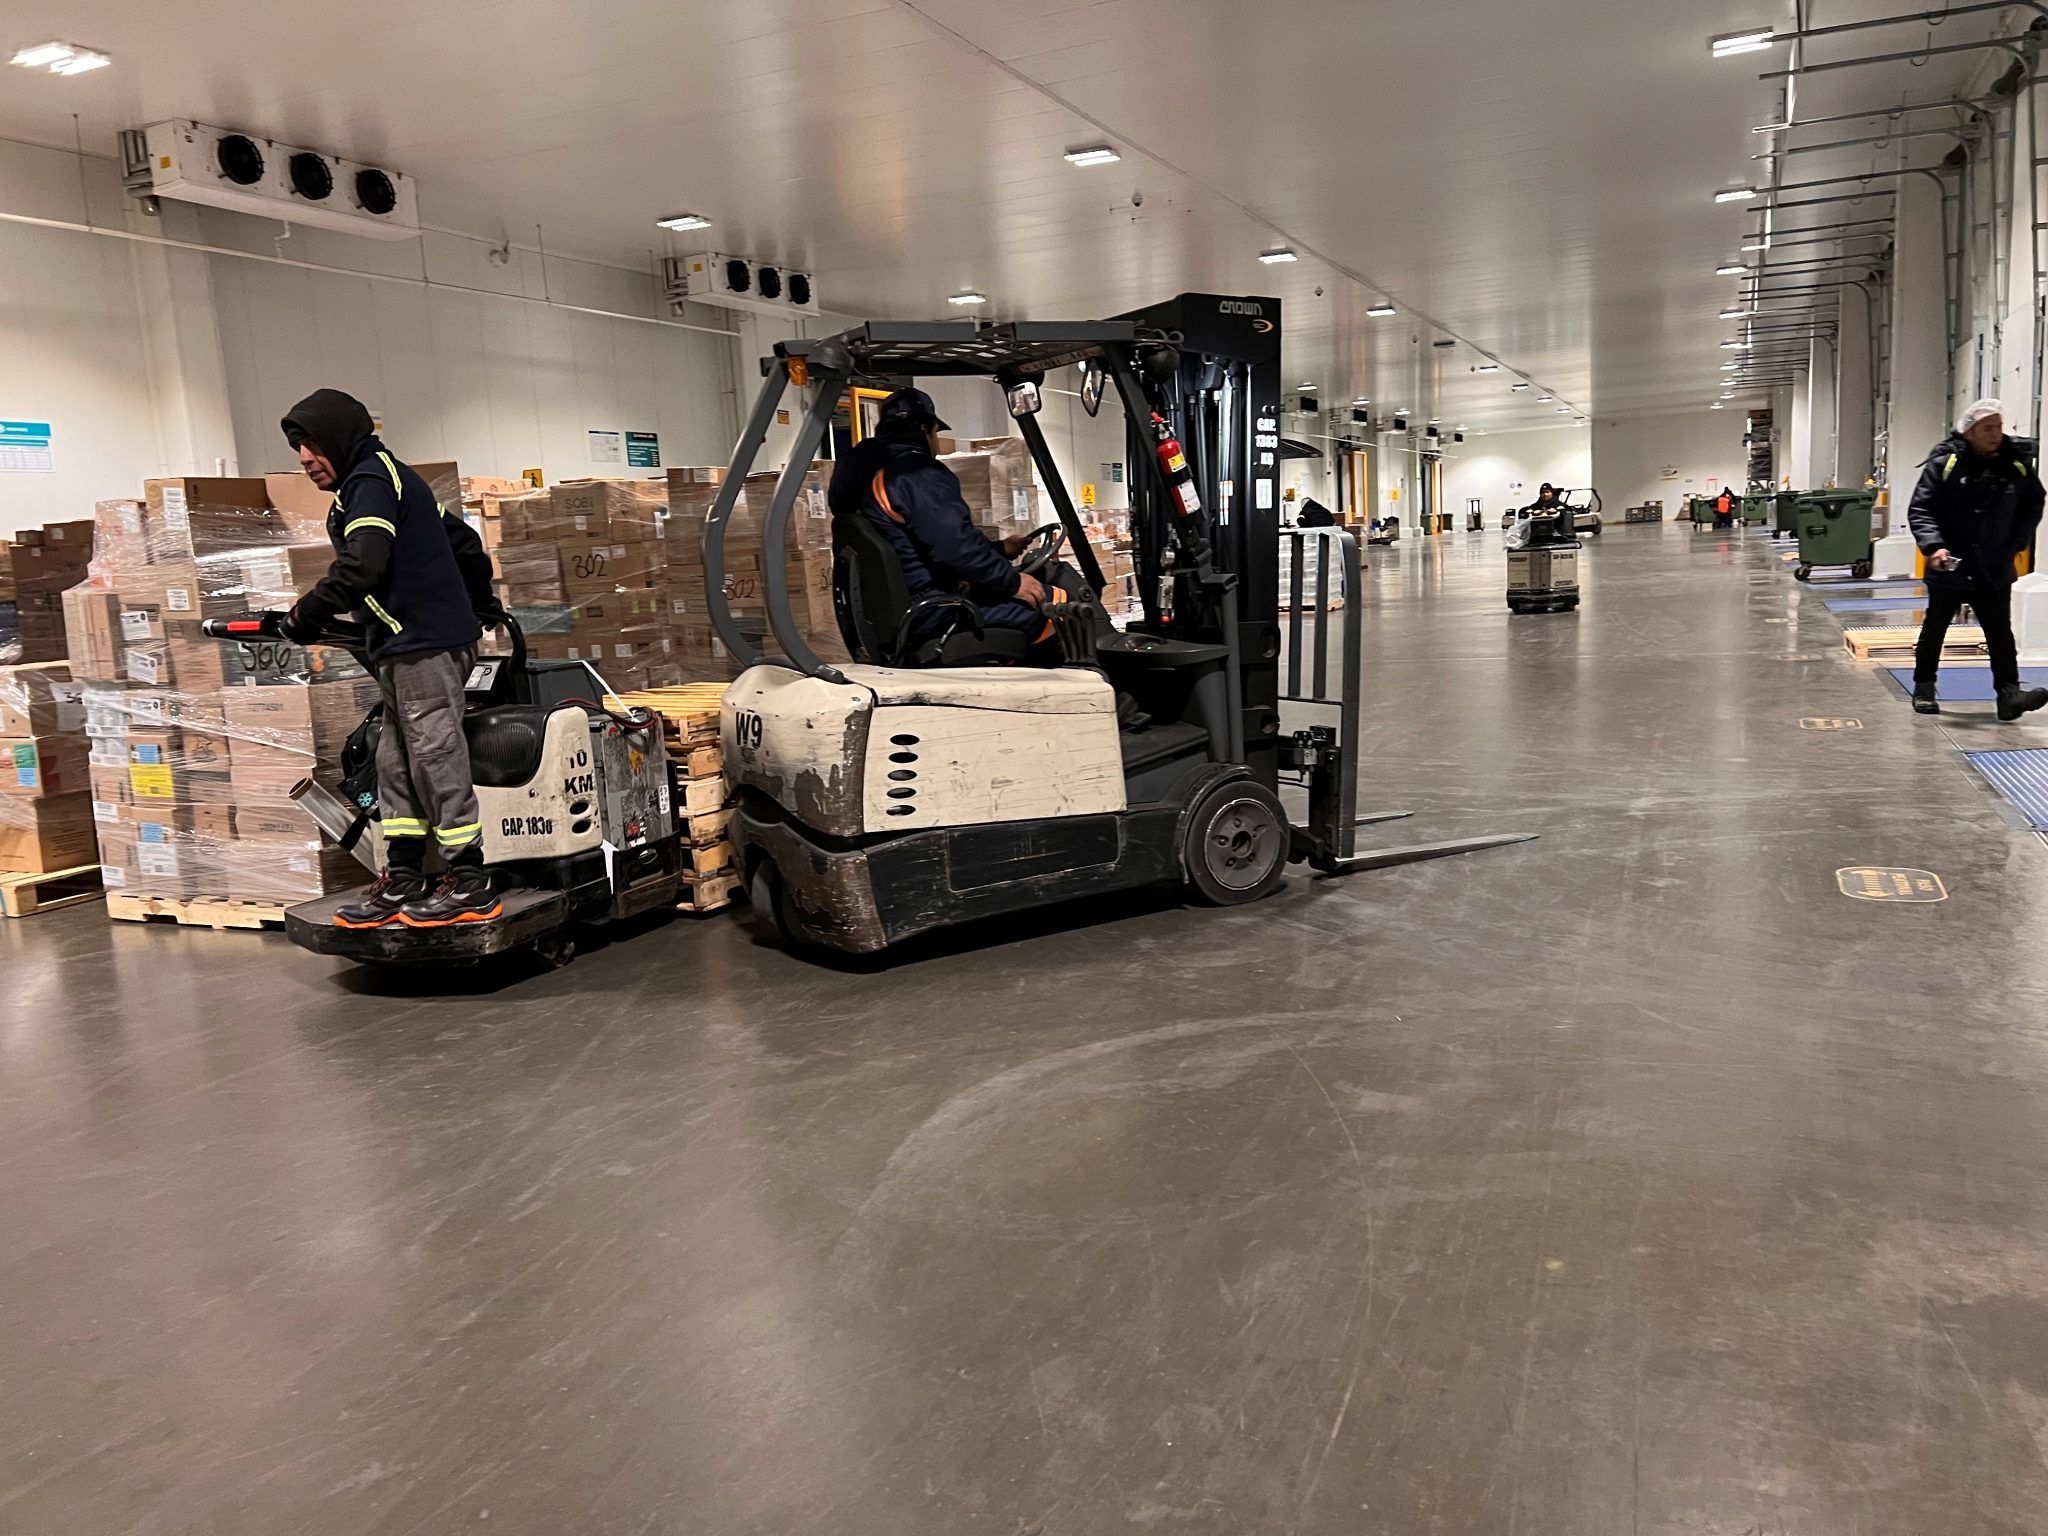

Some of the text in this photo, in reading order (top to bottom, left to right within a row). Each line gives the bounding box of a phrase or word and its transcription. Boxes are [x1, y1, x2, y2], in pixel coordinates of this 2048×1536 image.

[1219, 300, 1263, 316] CROWN
[571, 553, 607, 579] 302
[725, 579, 756, 601] 302
[735, 711, 763, 750] W9
[564, 773, 594, 795] KM
[501, 817, 525, 837] CAP.
